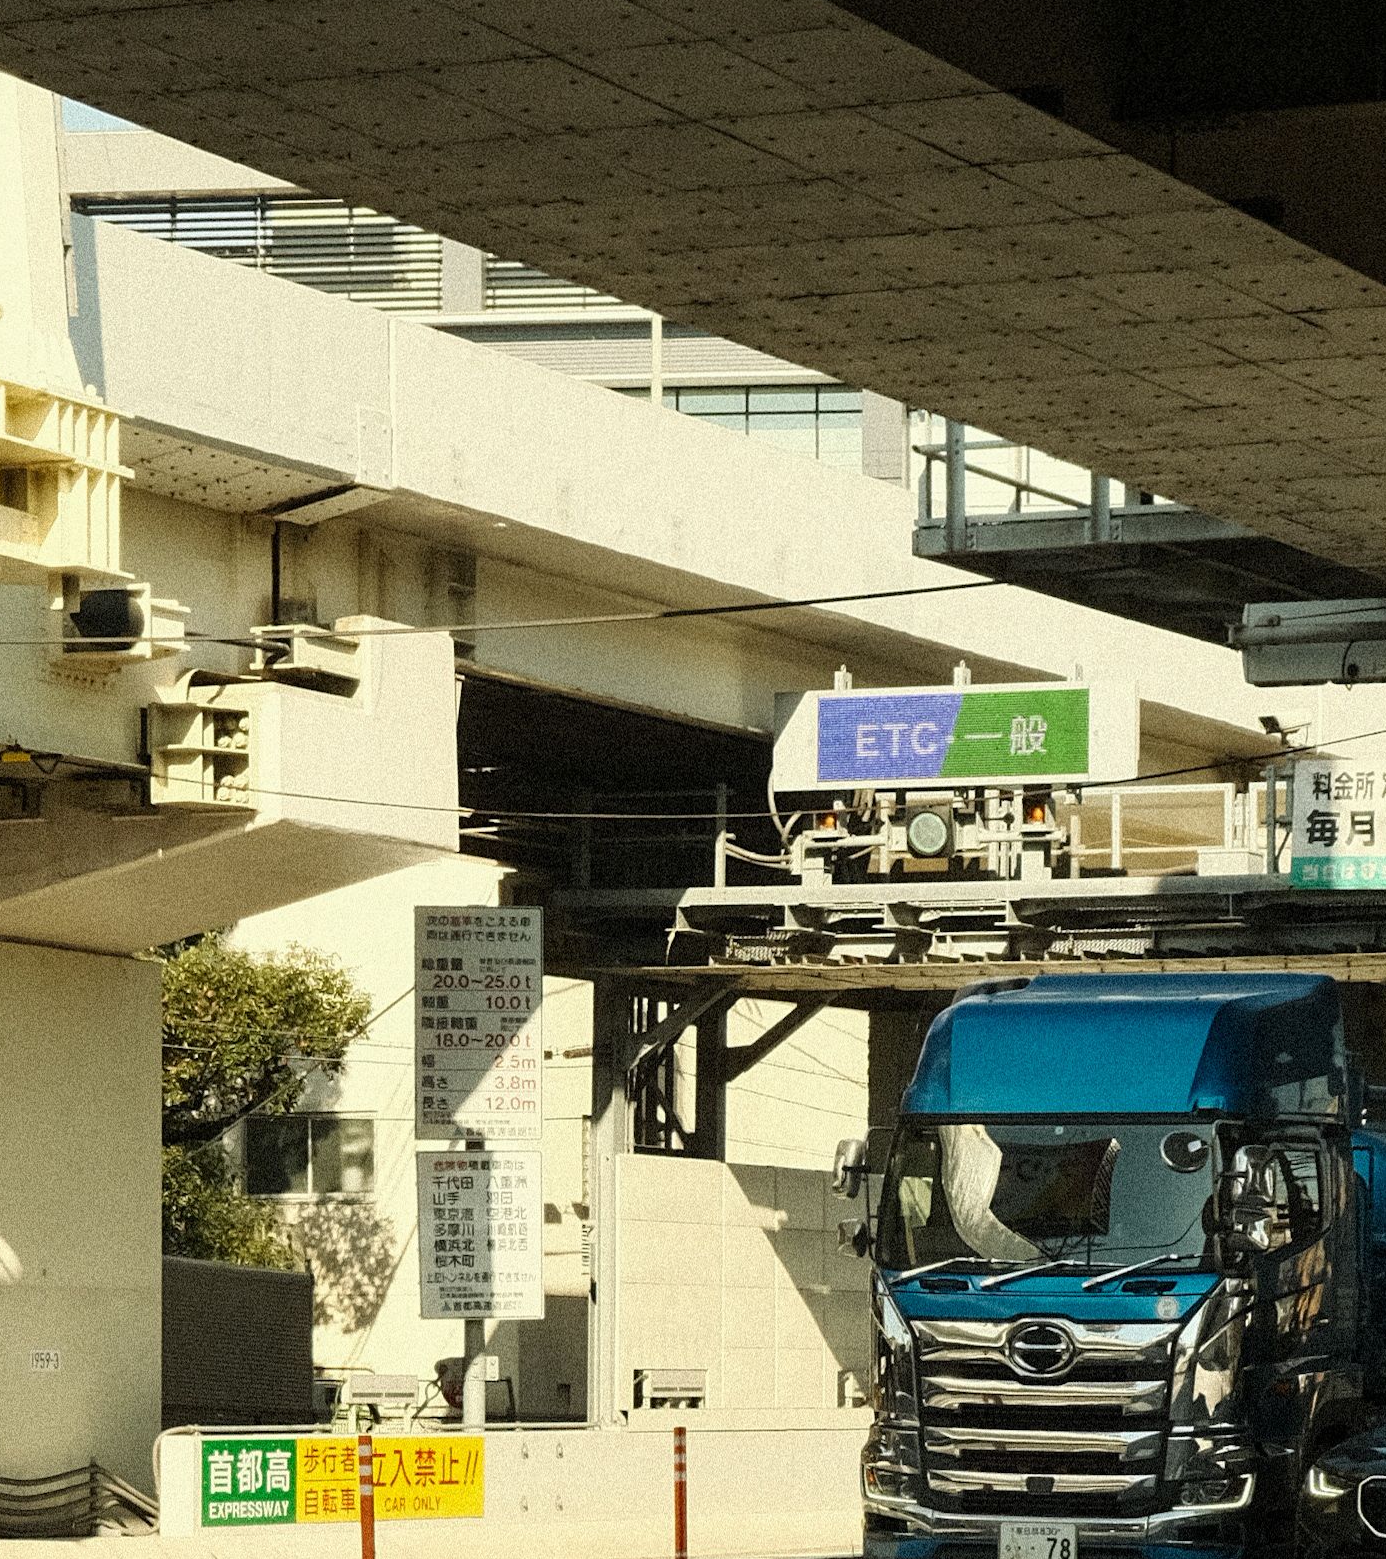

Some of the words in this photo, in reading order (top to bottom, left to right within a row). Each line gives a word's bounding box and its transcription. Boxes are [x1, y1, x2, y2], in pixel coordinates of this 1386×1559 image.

[1312, 771, 1375, 801] 料金所
[1306, 808, 1375, 848] 毎月
[421, 1075, 448, 1090] 高さ
[494, 1075, 537, 1090] 3.8m
[422, 1096, 448, 1110] 長さ
[485, 1096, 537, 1111] 12.0m
[431, 1176, 474, 1190] 千代田
[432, 1191, 461, 1206] 山手
[433, 1223, 475, 1237] 多摩川
[433, 1239, 475, 1253] 横浜北
[434, 1254, 475, 1269] 桜木町
[303, 1445, 357, 1475] 歩行者
[207, 1448, 292, 1495] 首都高
[303, 1487, 357, 1517] 自転車
[384, 1497, 407, 1513] CAR
[413, 1496, 441, 1512] ONLY
[208, 1500, 290, 1520] EXPRESSWAY
